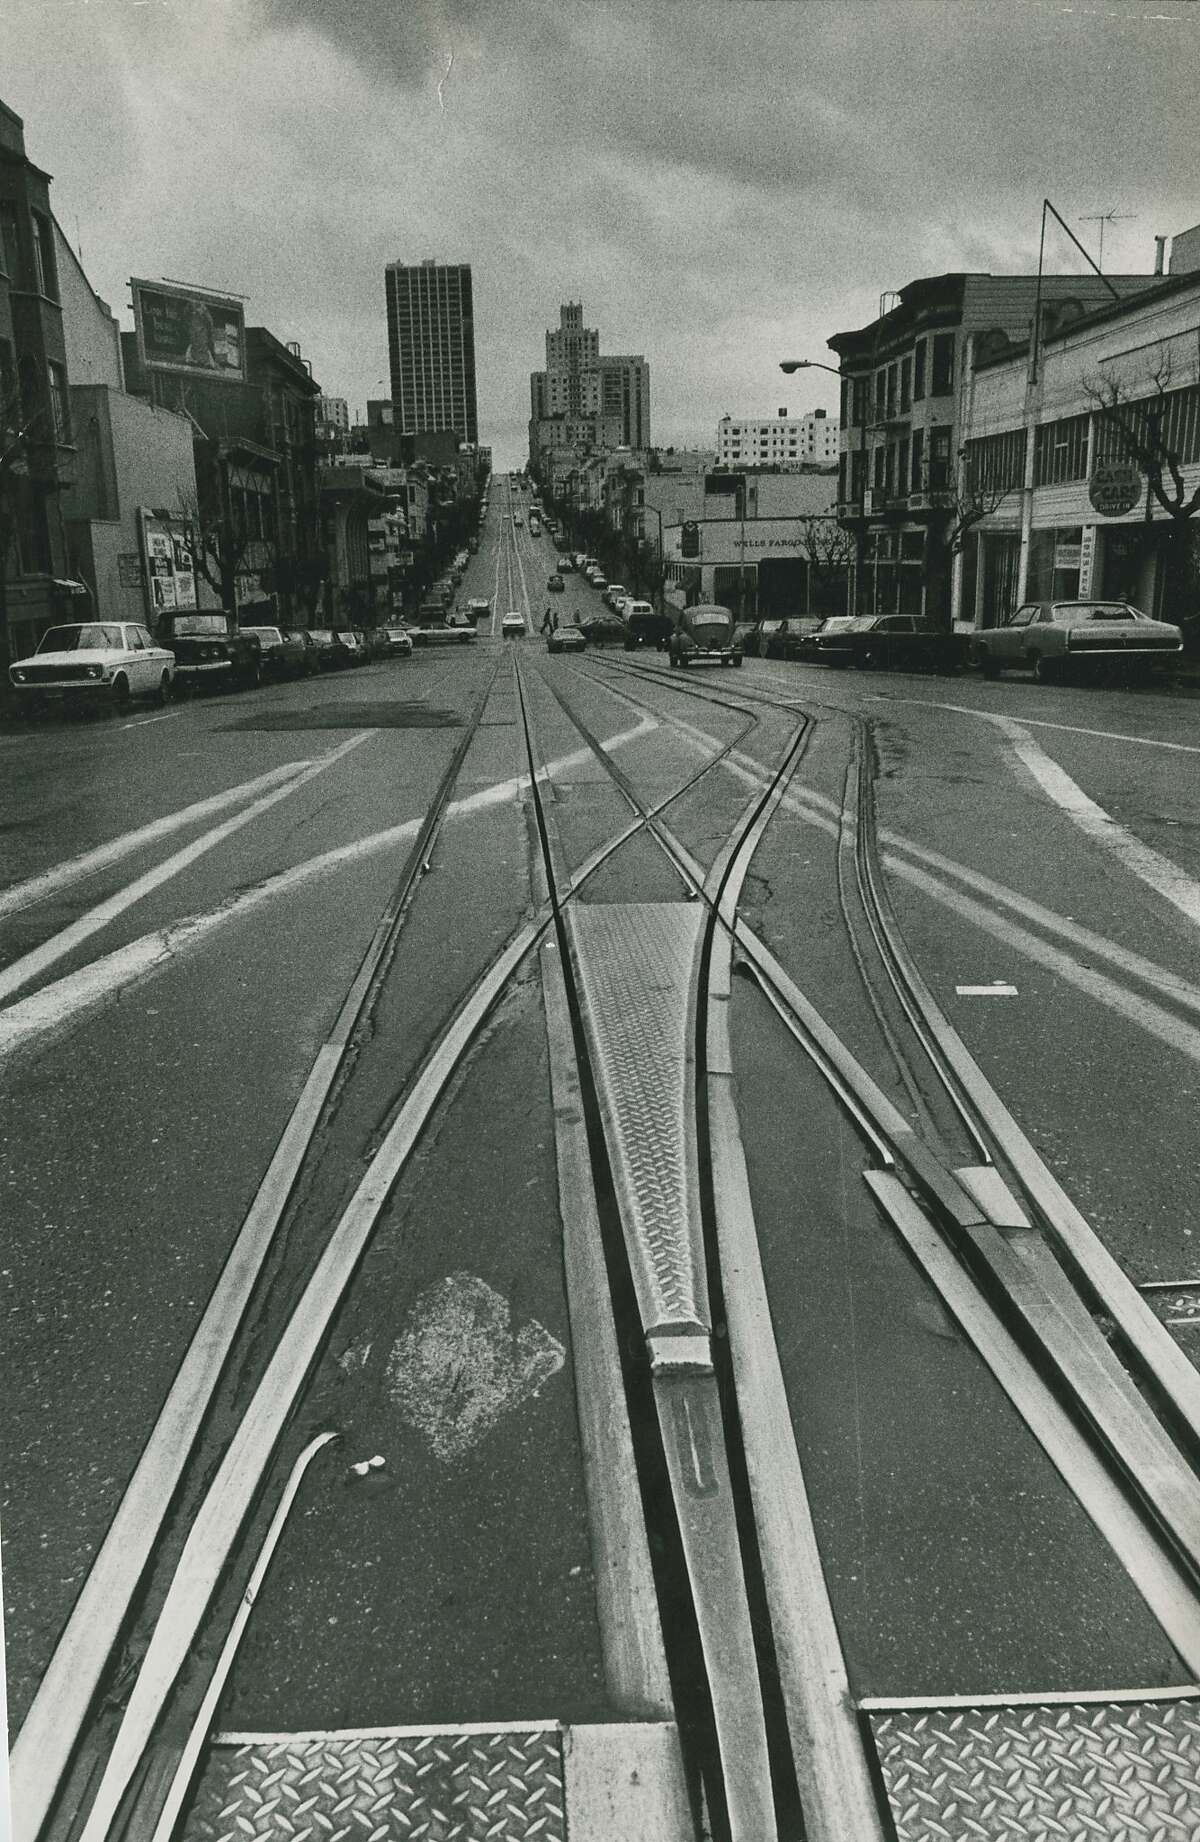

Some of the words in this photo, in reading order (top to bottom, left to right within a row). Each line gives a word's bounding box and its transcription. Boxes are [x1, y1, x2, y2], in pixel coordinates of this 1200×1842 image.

[1099, 503, 1120, 511] DRIVE
[733, 539, 766, 548] WELLS
[769, 539, 801, 547] FARGO
